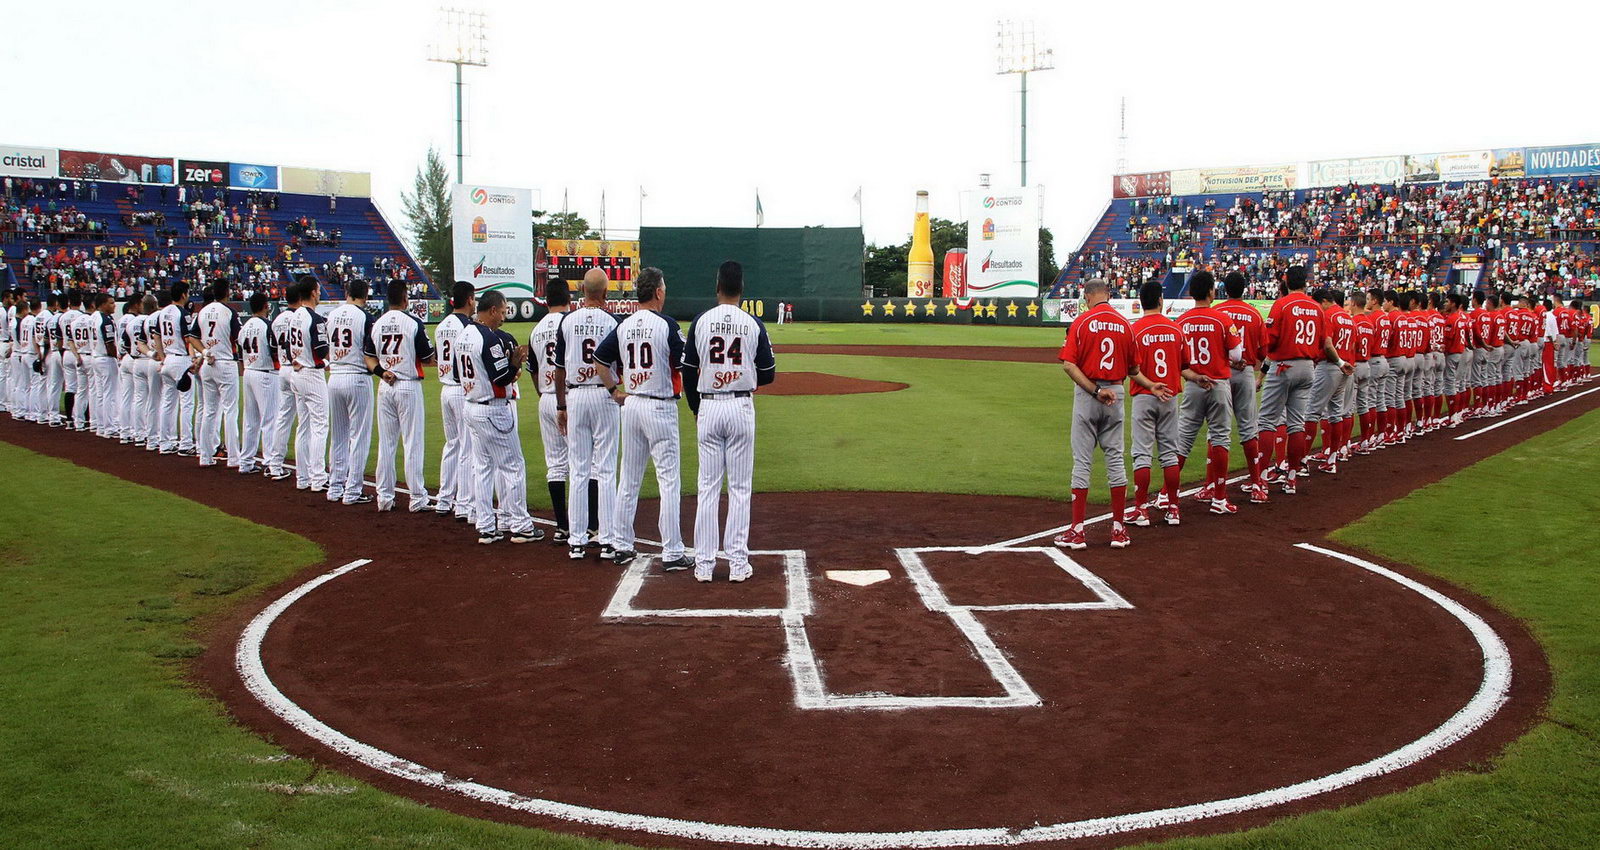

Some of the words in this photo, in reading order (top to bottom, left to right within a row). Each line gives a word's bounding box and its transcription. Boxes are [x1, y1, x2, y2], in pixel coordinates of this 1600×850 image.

[3, 152, 46, 168] cristal
[1531, 149, 1600, 169] NOVEDADES
[1206, 177, 1243, 185] NOTIVISION
[483, 266, 516, 275] Resultados
[991, 260, 1023, 269] Resultados
[740, 299, 764, 317] 410
[1291, 306, 1318, 317] Corona
[162, 321, 174, 337] 13
[208, 321, 216, 338] 7
[574, 324, 604, 337] ARZATE
[626, 328, 653, 340] CHAVEZ
[710, 322, 749, 336] CARRILLO
[1088, 319, 1125, 334] Corona
[1182, 322, 1215, 335] Corona
[1295, 319, 1316, 346] 29
[243, 336, 259, 354] 44
[331, 327, 353, 348] 43
[381, 334, 403, 355] 77
[1142, 333, 1175, 346] Corona
[1335, 327, 1352, 351] 27
[443, 339, 451, 361] 2
[582, 338, 596, 364] 6
[626, 341, 653, 369] 10
[709, 336, 742, 366] 24
[1099, 337, 1115, 371] 2
[1187, 337, 1211, 365] 18
[460, 354, 475, 379] 19
[1154, 348, 1168, 378] 8
